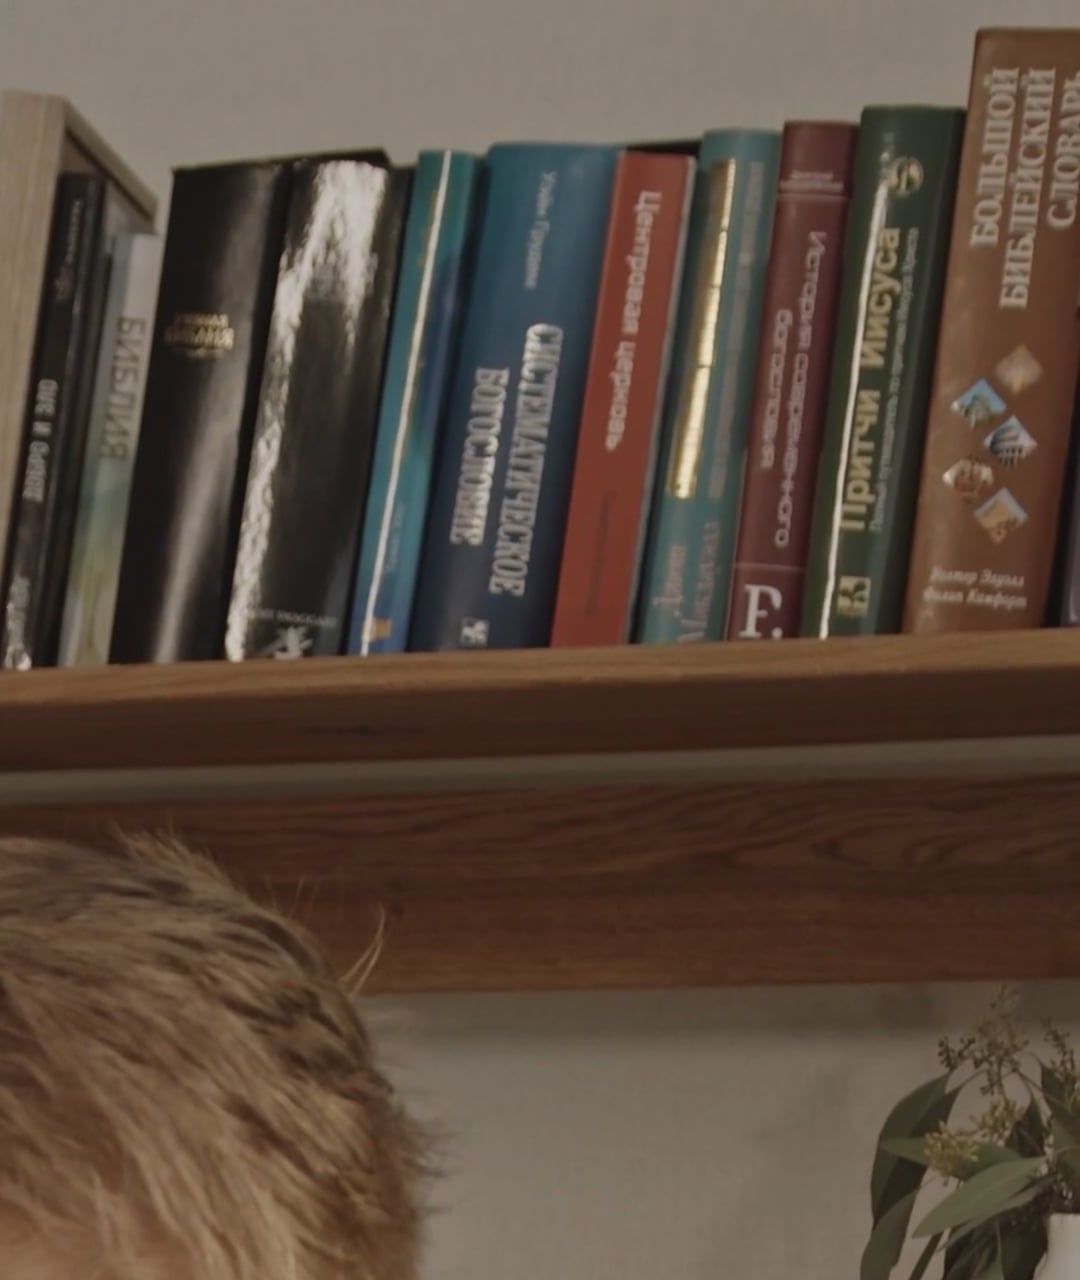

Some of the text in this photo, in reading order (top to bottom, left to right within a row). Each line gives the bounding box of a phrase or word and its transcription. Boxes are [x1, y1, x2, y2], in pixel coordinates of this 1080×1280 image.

[970, 66, 1020, 248] БОЛЬШОЙ
[1000, 66, 1057, 309] БИБЛЕЙСКИЙ
[605, 190, 662, 453] Центровая церковь
[797, 230, 828, 350] История
[838, 226, 902, 533] Притчи Иисуса
[22, 437, 50, 504] ДОБРО
[37, 378, 59, 415] ЗЛО
[98, 316, 146, 461] БИБЛИЯ
[449, 366, 511, 546] БОГОСЛОВИЕ
[488, 322, 565, 598] СИСТЕМАТИЧЕСКОЕ
[760, 308, 794, 470] богословия
[774, 352, 812, 548] современного
